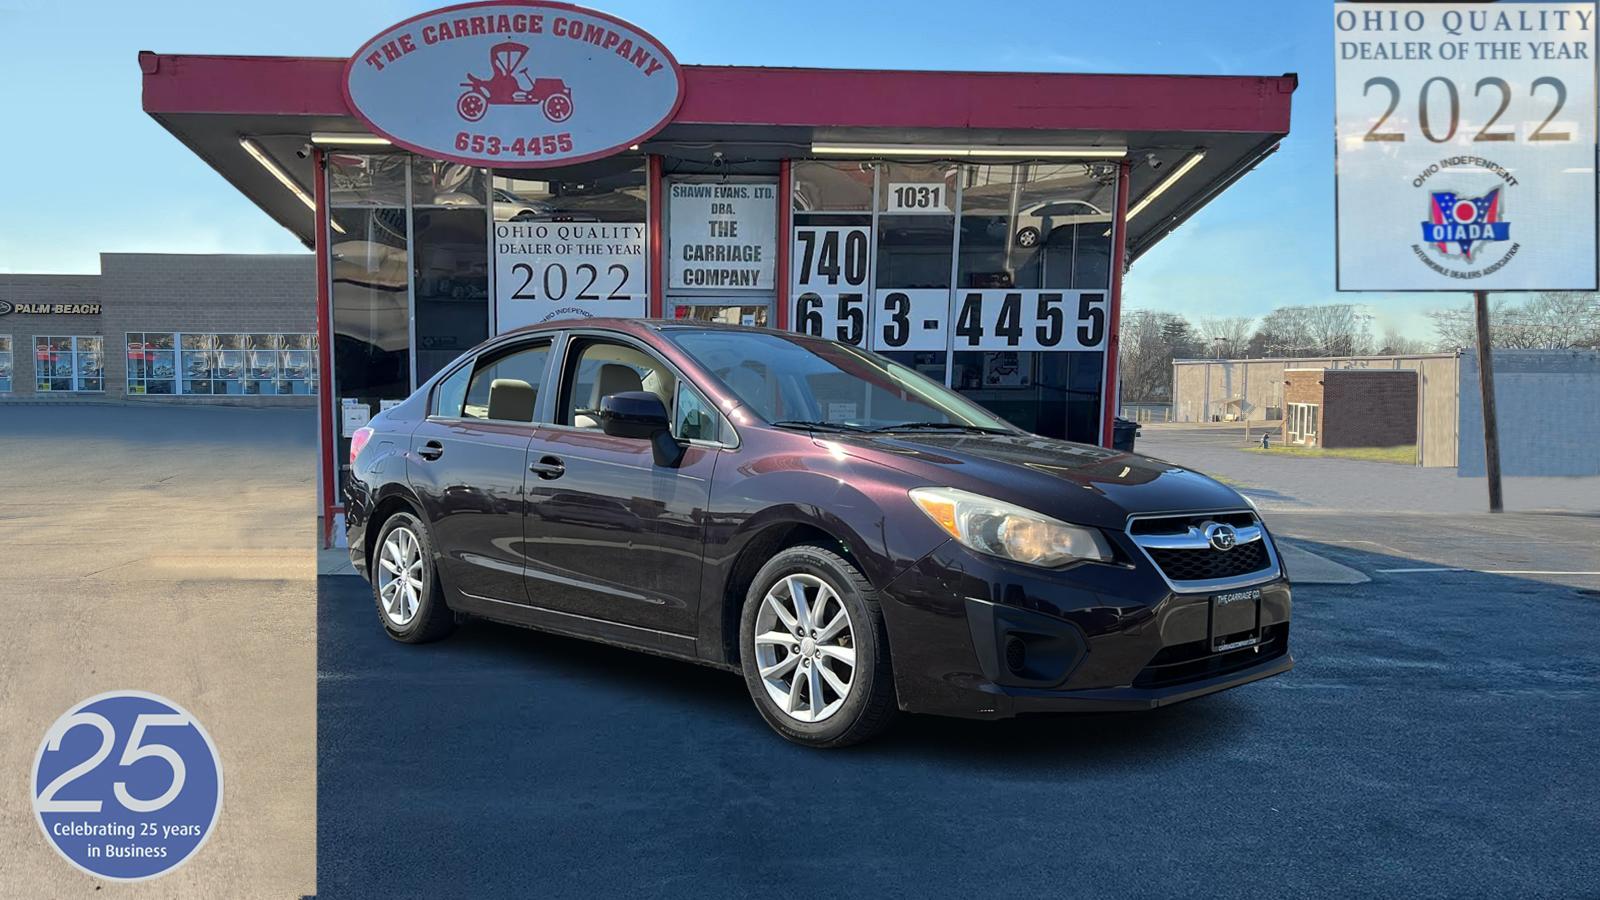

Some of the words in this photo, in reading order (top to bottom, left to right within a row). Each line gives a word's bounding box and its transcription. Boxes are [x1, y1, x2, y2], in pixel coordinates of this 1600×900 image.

[1336, 10, 1426, 32] OHIO
[1442, 10, 1593, 36] QUALITY
[366, 34, 416, 72] THE
[422, 14, 544, 45] CARRIAGE
[552, 17, 664, 77] COMPANY
[1340, 41, 1433, 60] DEALER
[1439, 41, 1470, 61] OF
[1475, 41, 1523, 60] THE
[1528, 41, 1589, 60] YEAR
[1363, 76, 1571, 143] 2022
[454, 132, 574, 157] 653-4455
[1412, 164, 1440, 189] OHIO
[1440, 155, 1519, 188] INDEPENDENT
[672, 185, 712, 199] SHAWN
[754, 187, 775, 200] LTD.
[893, 186, 940, 209] 1031
[711, 203, 736, 216] DBA.
[497, 226, 548, 239] OHIO
[557, 226, 644, 241] QUALITY
[708, 220, 738, 238] THE
[1432, 224, 1495, 241] OIADA
[499, 243, 552, 254] DEALER
[555, 243, 573, 255] OF
[576, 244, 602, 255] THE
[607, 244, 642, 255] YEAR
[683, 244, 762, 262] CARRIAGE
[797, 230, 868, 286] 740
[511, 263, 632, 301] 2022
[683, 268, 760, 286] COMPANY
[1217, 594, 1228, 605] THE
